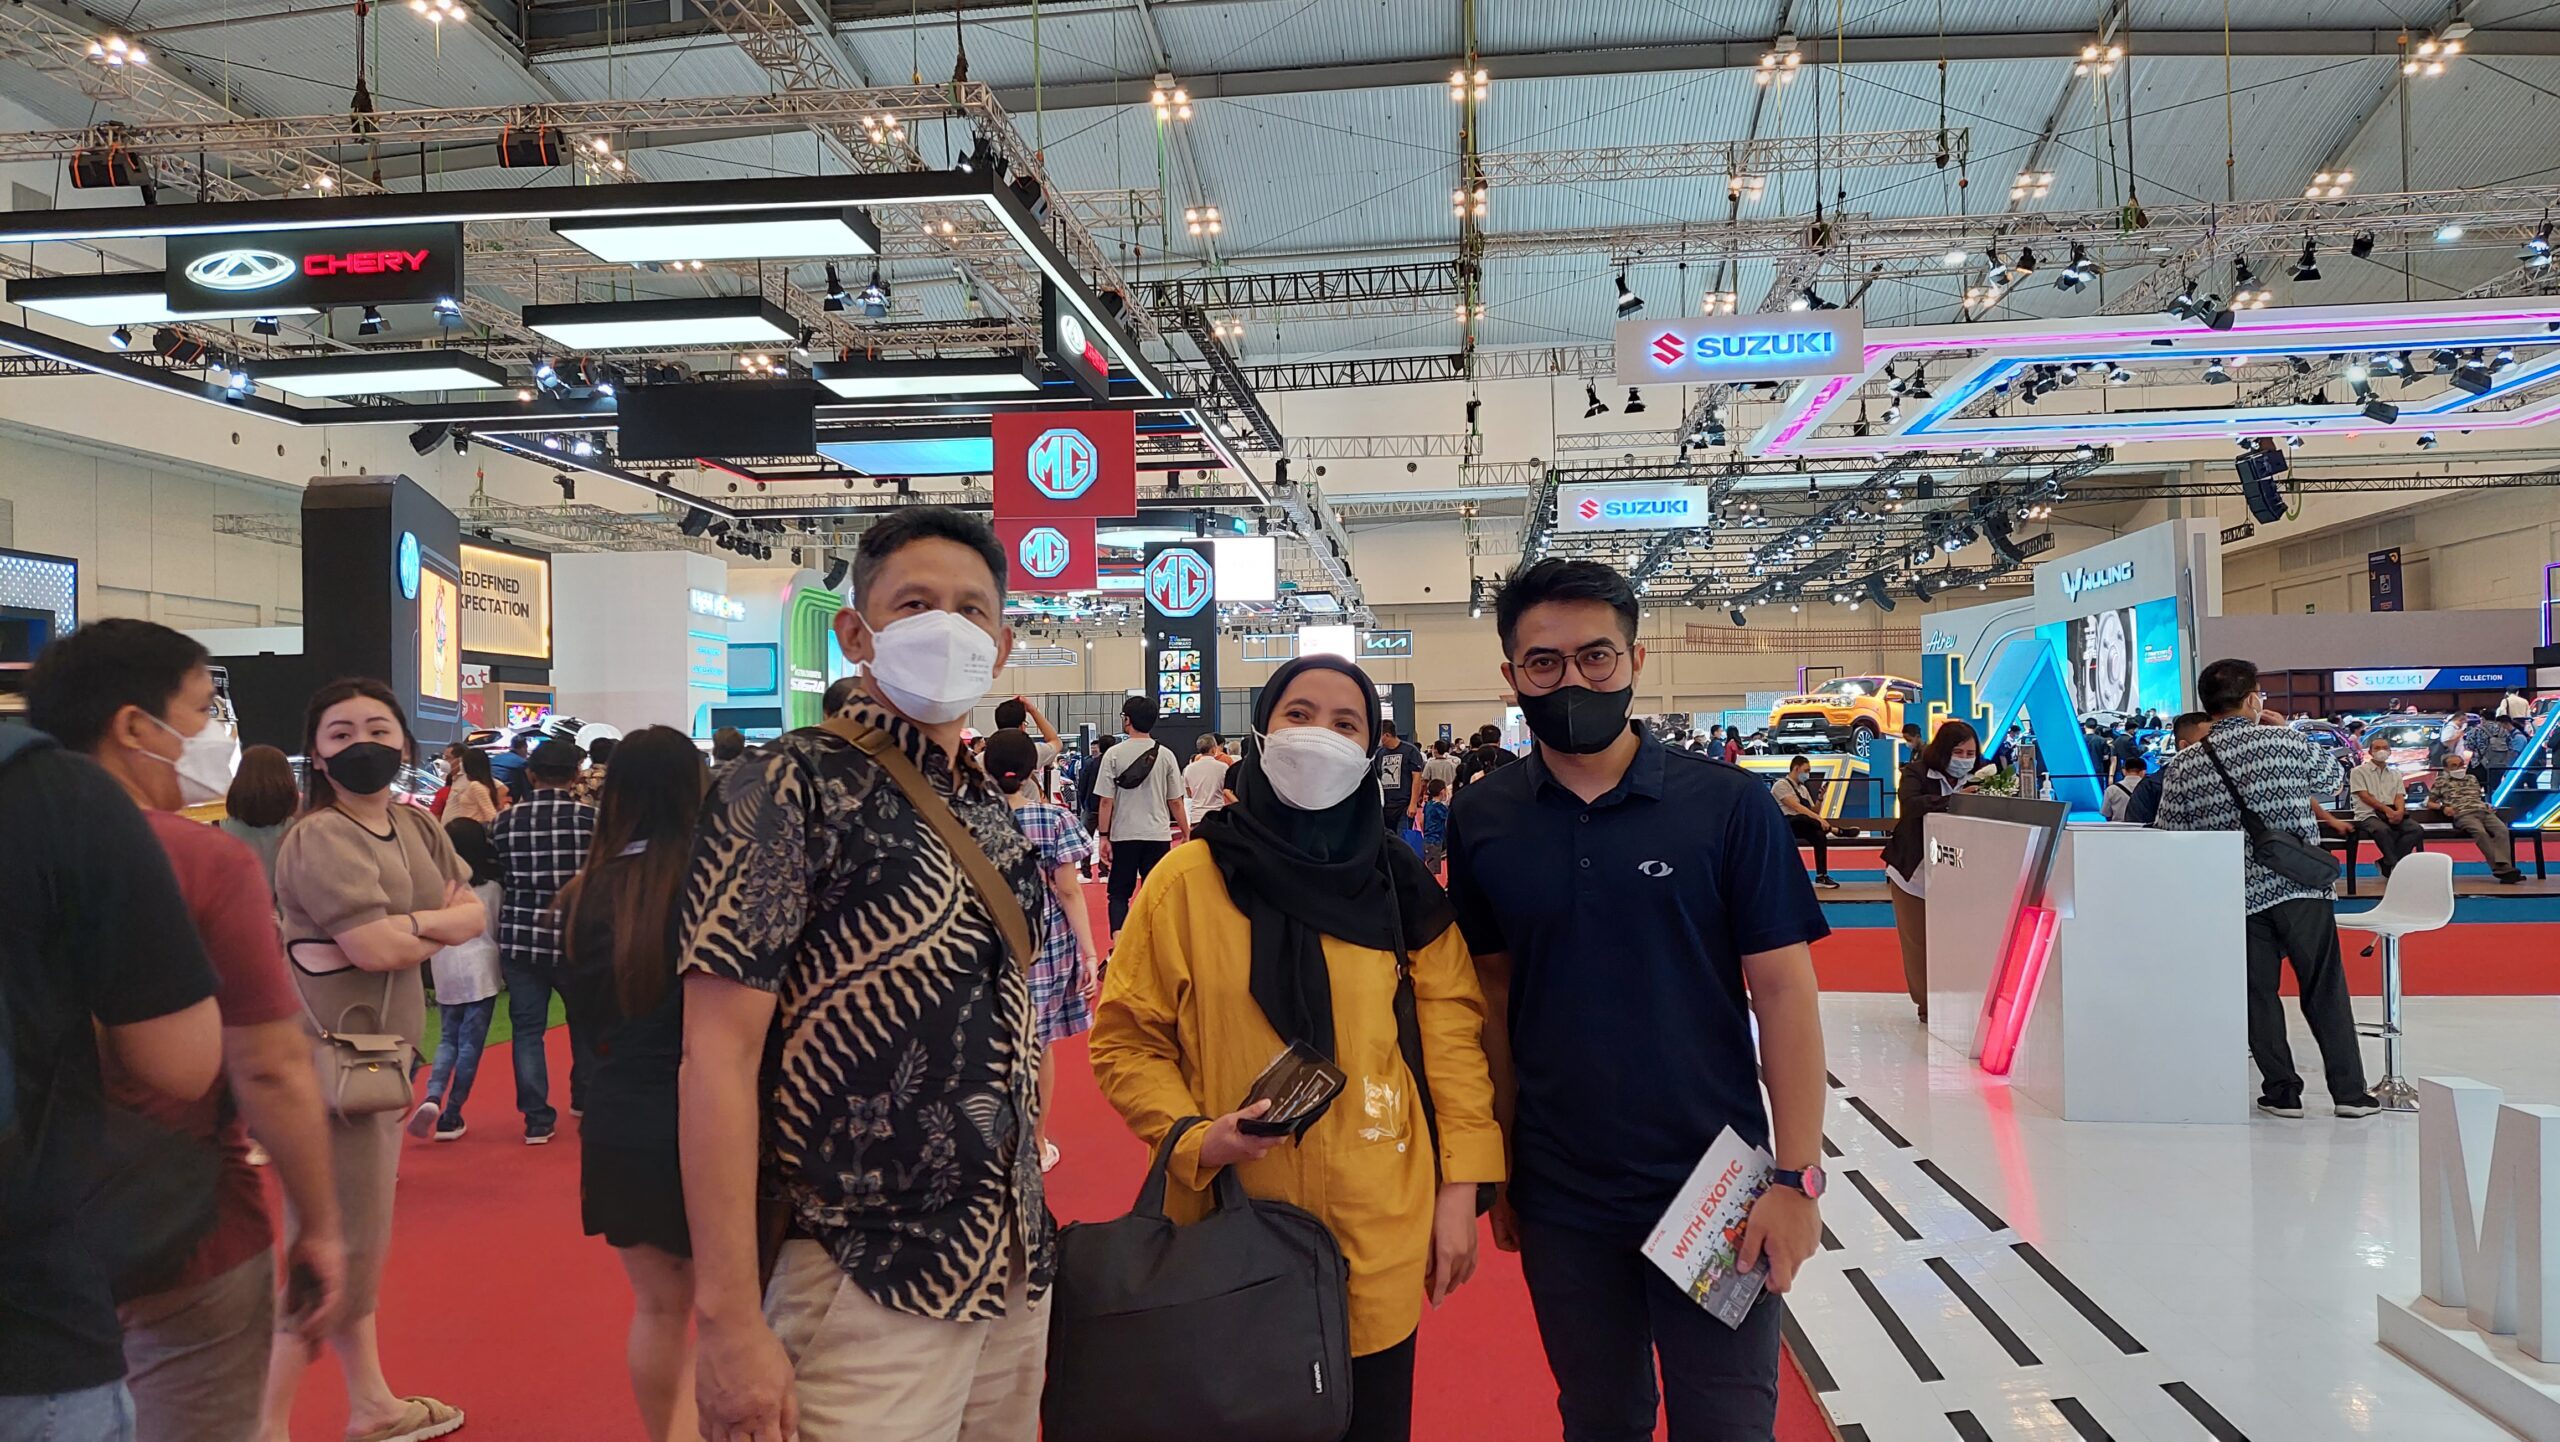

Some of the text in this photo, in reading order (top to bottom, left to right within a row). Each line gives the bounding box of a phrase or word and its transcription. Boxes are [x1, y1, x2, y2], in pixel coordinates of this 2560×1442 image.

[303, 249, 430, 276] CHERY
[1697, 331, 1832, 358] SUZUKI
[1034, 435, 1090, 491] MG
[1605, 500, 1688, 516] SUZUKI
[1024, 531, 1065, 573] MG
[1152, 554, 1206, 610] MG
[2082, 561, 2133, 592] WULING
[2365, 674, 2503, 686] SUZUKI COLLECTION
[1383, 754, 1402, 766] PUMA
[1672, 1158, 1743, 1260] WITH EXOTIC
[1313, 1361, 1322, 1393] Lenovo
